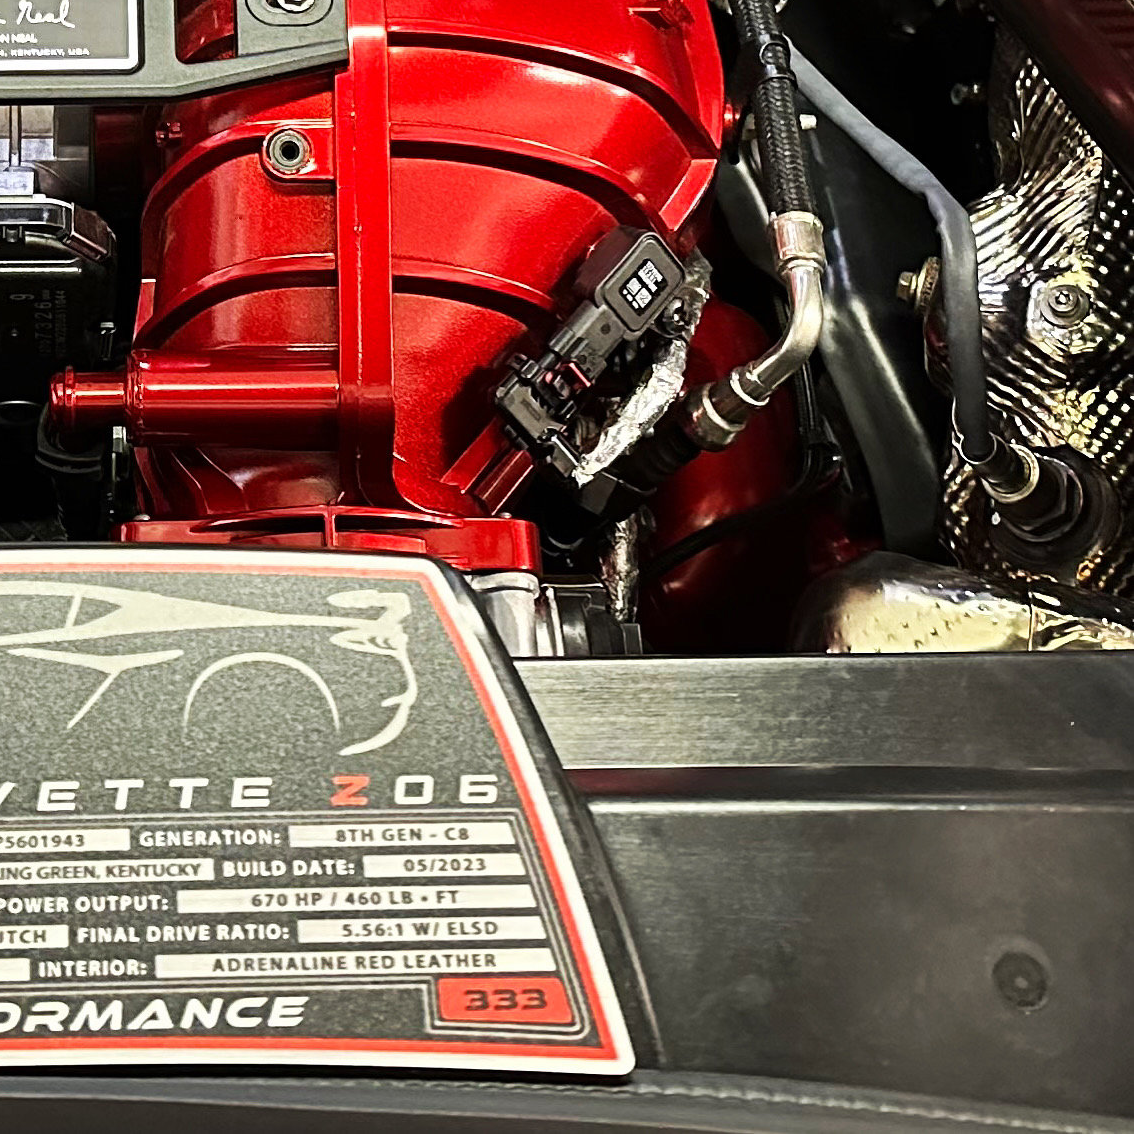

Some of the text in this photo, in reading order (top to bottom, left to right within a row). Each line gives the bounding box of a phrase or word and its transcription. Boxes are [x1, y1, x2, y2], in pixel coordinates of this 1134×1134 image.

[330, 774, 499, 807] Z06
[139, 830, 281, 848] GENERATION:
[336, 829, 374, 843] 8TH
[382, 828, 422, 842] GEN
[444, 827, 469, 841] C8
[37, 866, 100, 882] GREEN,
[105, 864, 200, 879] KENTUCKY
[222, 858, 487, 877] BUILD DATE: 05/2023
[75, 895, 169, 912] OUTPUT:
[251, 893, 288, 907] 670
[295, 892, 322, 906] HP
[344, 891, 382, 905] 460
[389, 891, 412, 905] LB
[436, 890, 459, 904] FT
[76, 921, 498, 943] FINAL DRIVE RATIO: 5.56:1 W/ ELSD
[38, 953, 497, 977] INTERIOR: ADRENALINE RED LEATHER
[463, 988, 547, 1011] 333
